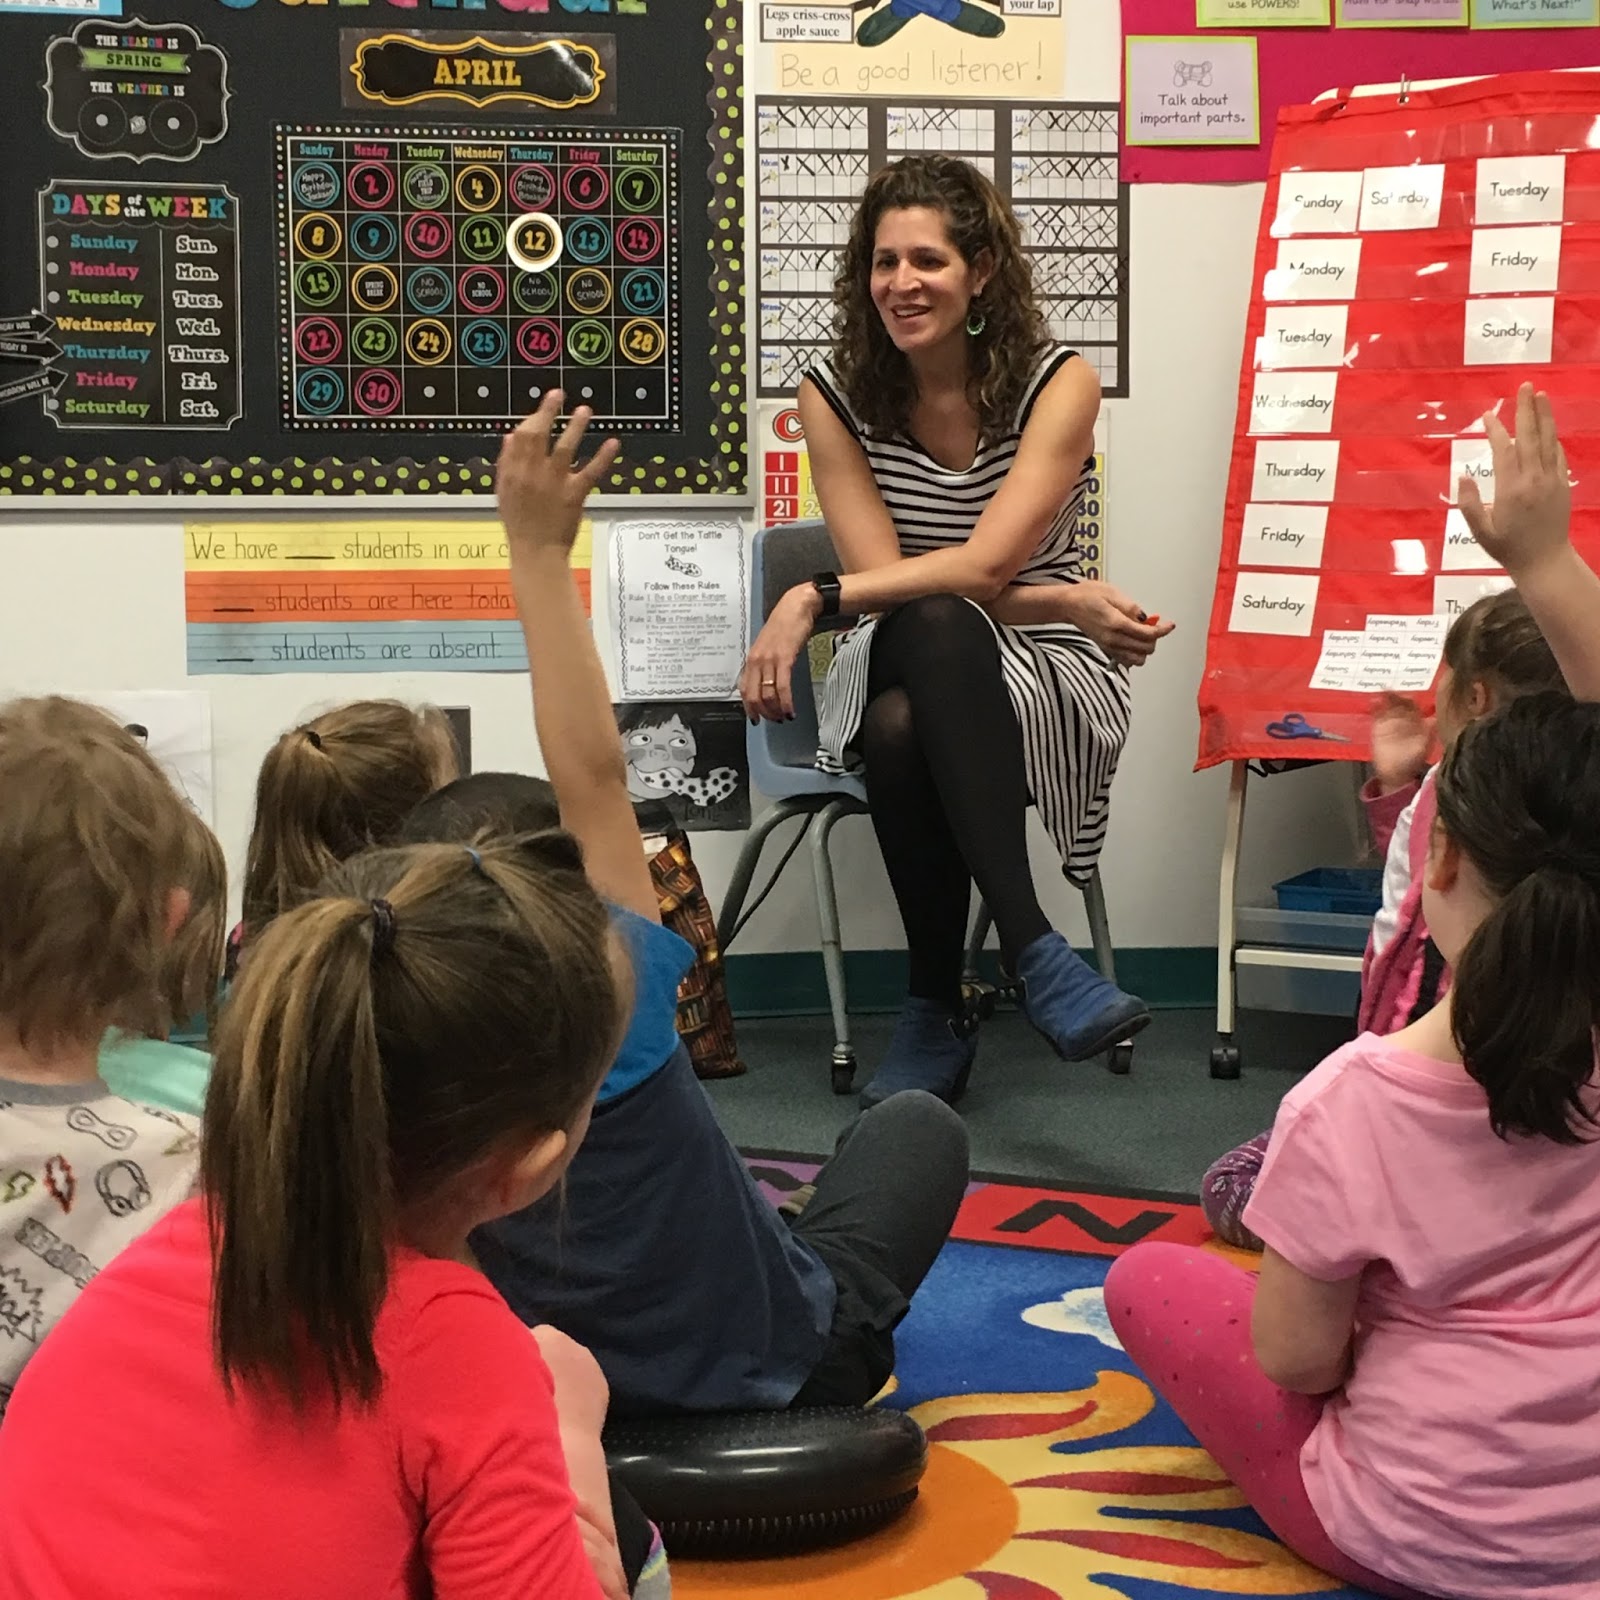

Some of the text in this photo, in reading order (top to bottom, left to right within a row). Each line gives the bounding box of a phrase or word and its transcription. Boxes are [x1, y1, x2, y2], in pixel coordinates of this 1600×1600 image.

[1009, 0, 1055, 11] your lap
[1228, 0, 1300, 9] use POWERS!
[1492, 0, 1537, 10] What's
[765, 8, 851, 22] Legs criss-cross
[776, 26, 840, 38] apple sauce
[95, 35, 179, 49] THE SEASON IS
[106, 53, 162, 67] SPRING
[780, 41, 1042, 92] Be a good listener!
[433, 58, 521, 86] APRIL
[90, 82, 185, 96] THE WEATHER IS
[1158, 94, 1228, 106] Talk about
[1140, 112, 1245, 127] important parts.
[300, 143, 658, 164] Sunday Monday Tuesday Wednesday Thursday Friday Saturday
[364, 174, 379, 195] 2
[472, 178, 483, 199] 4
[580, 177, 591, 196] 6
[632, 180, 644, 199] 7
[1490, 181, 1550, 201] Tuesday
[52, 194, 226, 219] DAYS of the WEEK
[70, 234, 218, 253] Sunday Sun.
[312, 226, 325, 246] 8
[368, 228, 380, 247] 9
[417, 223, 440, 246] 10
[472, 227, 493, 248] 11
[524, 230, 546, 251] 12
[578, 230, 599, 251] 13
[628, 228, 649, 249] 14
[69, 261, 219, 280] Monday Mon.
[1491, 252, 1538, 271] Friday
[307, 272, 330, 294] 15
[421, 277, 435, 287] NO
[529, 277, 541, 285] NO
[581, 280, 593, 288] NO
[67, 289, 223, 308] Tuesday Tues.
[416, 288, 445, 298] SCHOOL
[521, 287, 553, 296] SCHOOL
[576, 290, 605, 300] SCHOOL
[632, 282, 654, 302] 21
[56, 317, 220, 336] Wednesday Wed.
[1278, 323, 1535, 347] Tuesday Sunday
[307, 330, 331, 350] 22
[362, 330, 386, 351] 23
[417, 331, 440, 352] 24
[474, 333, 495, 352] 25
[528, 330, 550, 351] 26
[577, 333, 602, 353] 27
[630, 330, 654, 352] 28
[64, 345, 229, 364] Thursday Thurs.
[76, 372, 217, 390] Friday Fri.
[310, 380, 333, 401] 29
[365, 381, 390, 403] 30
[65, 399, 219, 418] Saturday Sat.
[1255, 395, 1332, 413] Wednesday
[780, 454, 784, 471] 1
[1265, 463, 1325, 482] Thursday
[775, 477, 789, 494] 11
[773, 500, 790, 517] 21
[639, 531, 722, 540] Don't Get the Tattle
[1075, 522, 1099, 539] 40
[1261, 527, 1305, 547] Friday
[191, 532, 225, 560] We
[235, 532, 278, 559] have
[342, 532, 423, 559] students
[434, 544, 449, 559] in
[458, 544, 490, 558] our
[664, 544, 697, 554] Tongue!
[644, 581, 720, 590] Follow these Rules
[266, 584, 510, 611] students are here toda
[674, 593, 699, 602] Danger
[702, 593, 726, 602] Ranger
[1242, 594, 1305, 616] Saturday
[1368, 618, 1439, 628] Friday Wednesday
[272, 633, 366, 661] students
[381, 644, 412, 659] are
[1328, 633, 1438, 645] Tuesday Thursday Saturday
[1325, 649, 1436, 659] Monday Wednesday Saturday
[1324, 665, 1349, 674] Sunday
[1403, 666, 1431, 674] Tuesday
[1321, 678, 1343, 687] Friday
[1357, 680, 1386, 689] Thursday
